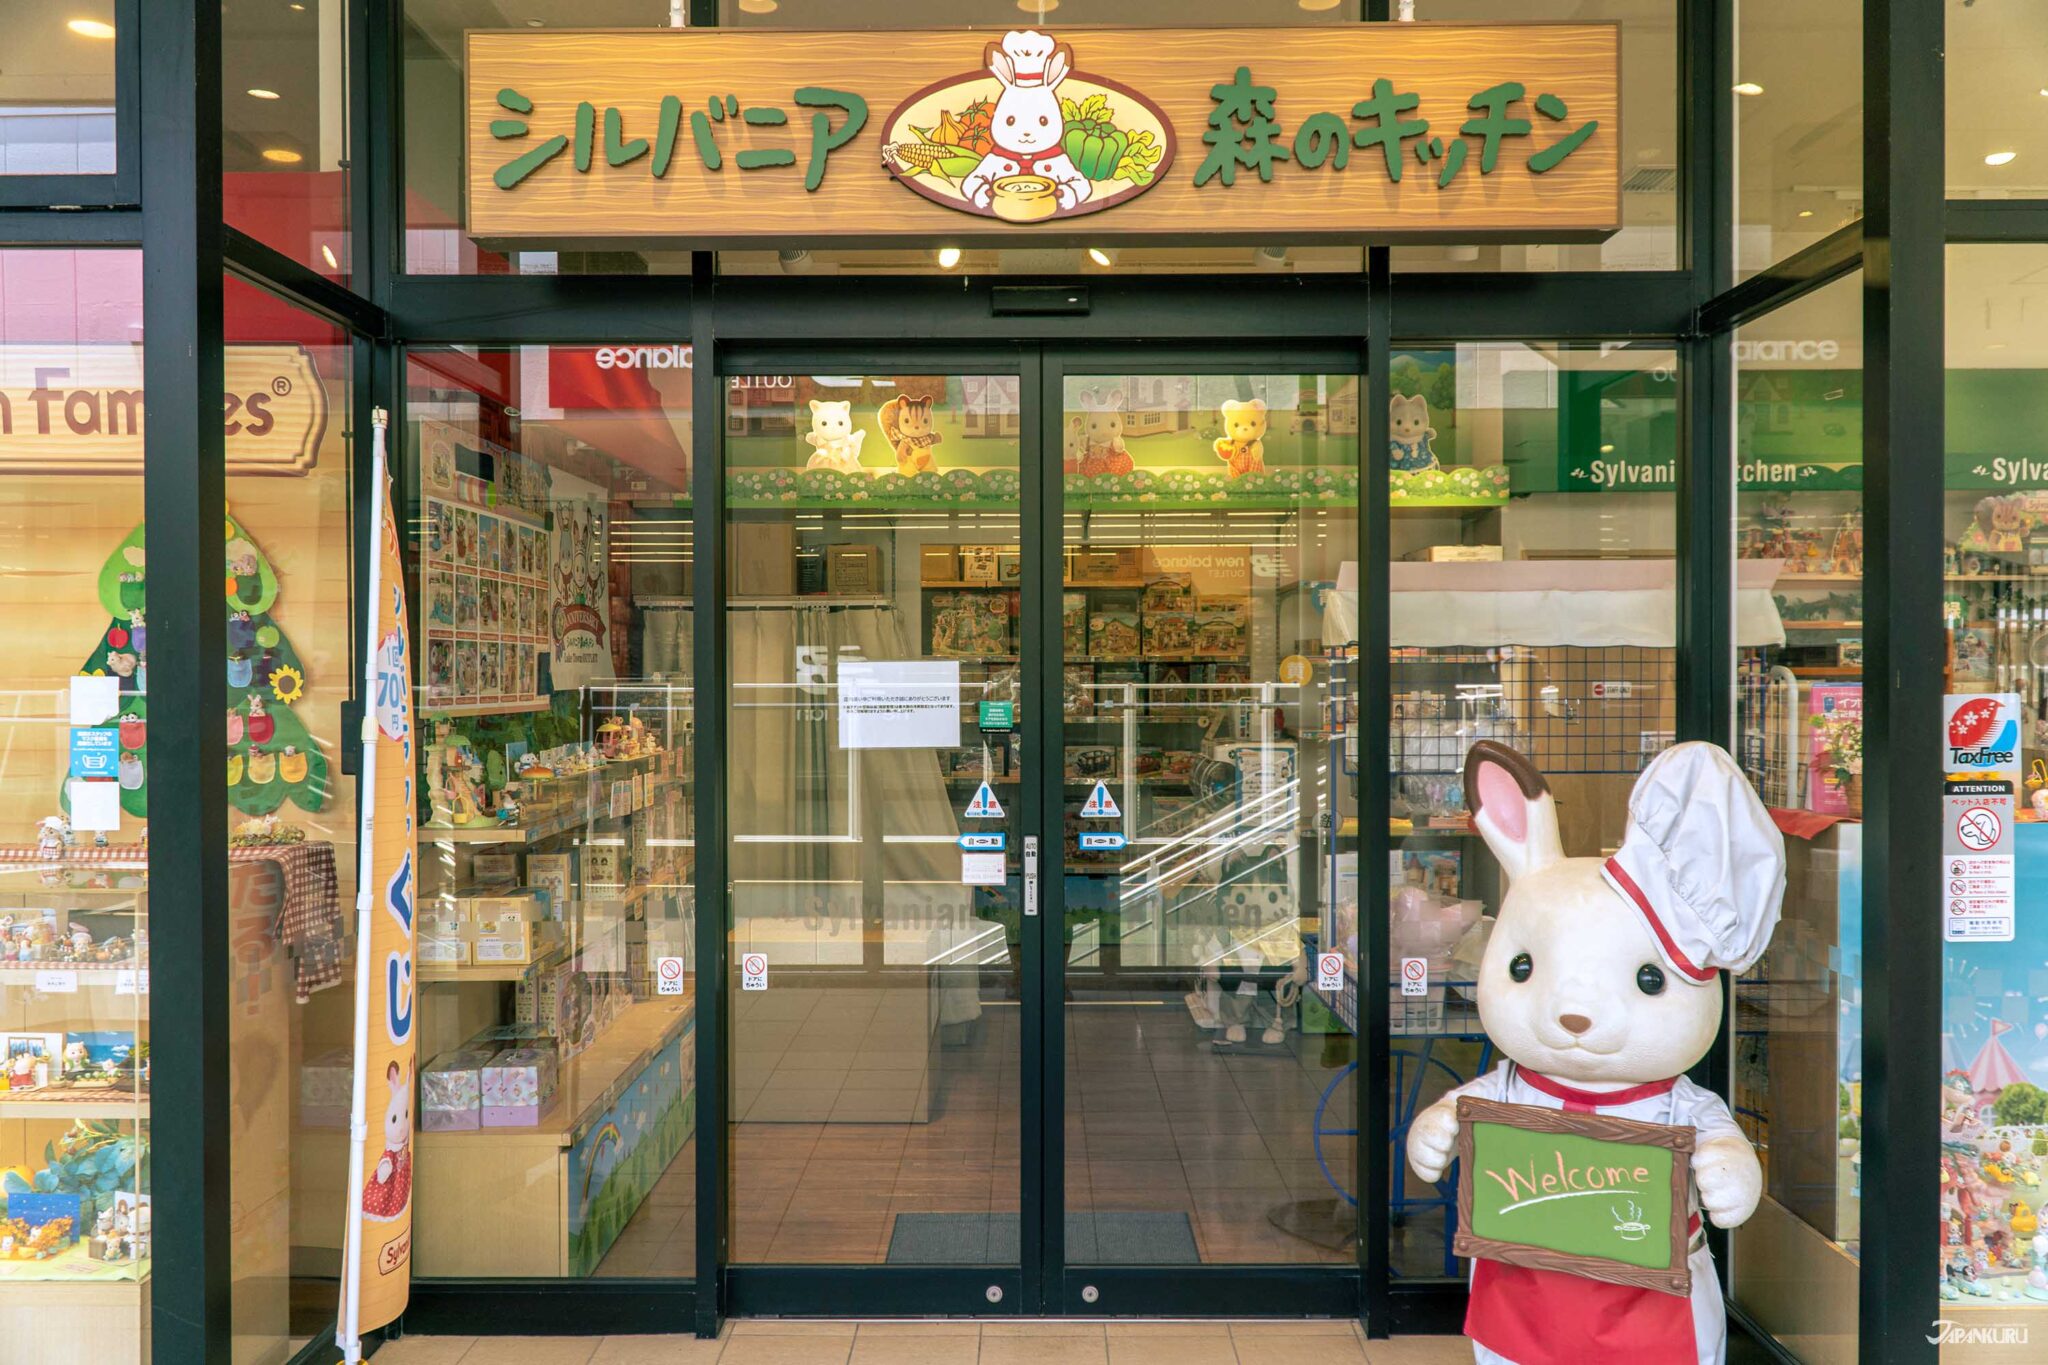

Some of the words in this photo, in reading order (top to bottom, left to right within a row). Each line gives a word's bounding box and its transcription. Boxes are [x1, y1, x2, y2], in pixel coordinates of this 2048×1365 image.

[489, 86, 869, 192] シルバニア
[1194, 66, 1599, 187] 森のキッチン
[1590, 460, 1677, 487] Sylvani
[1949, 747, 2014, 764] TaxFree
[1952, 785, 2006, 793] ATTENTION
[1485, 1151, 1651, 1201] Welcome
